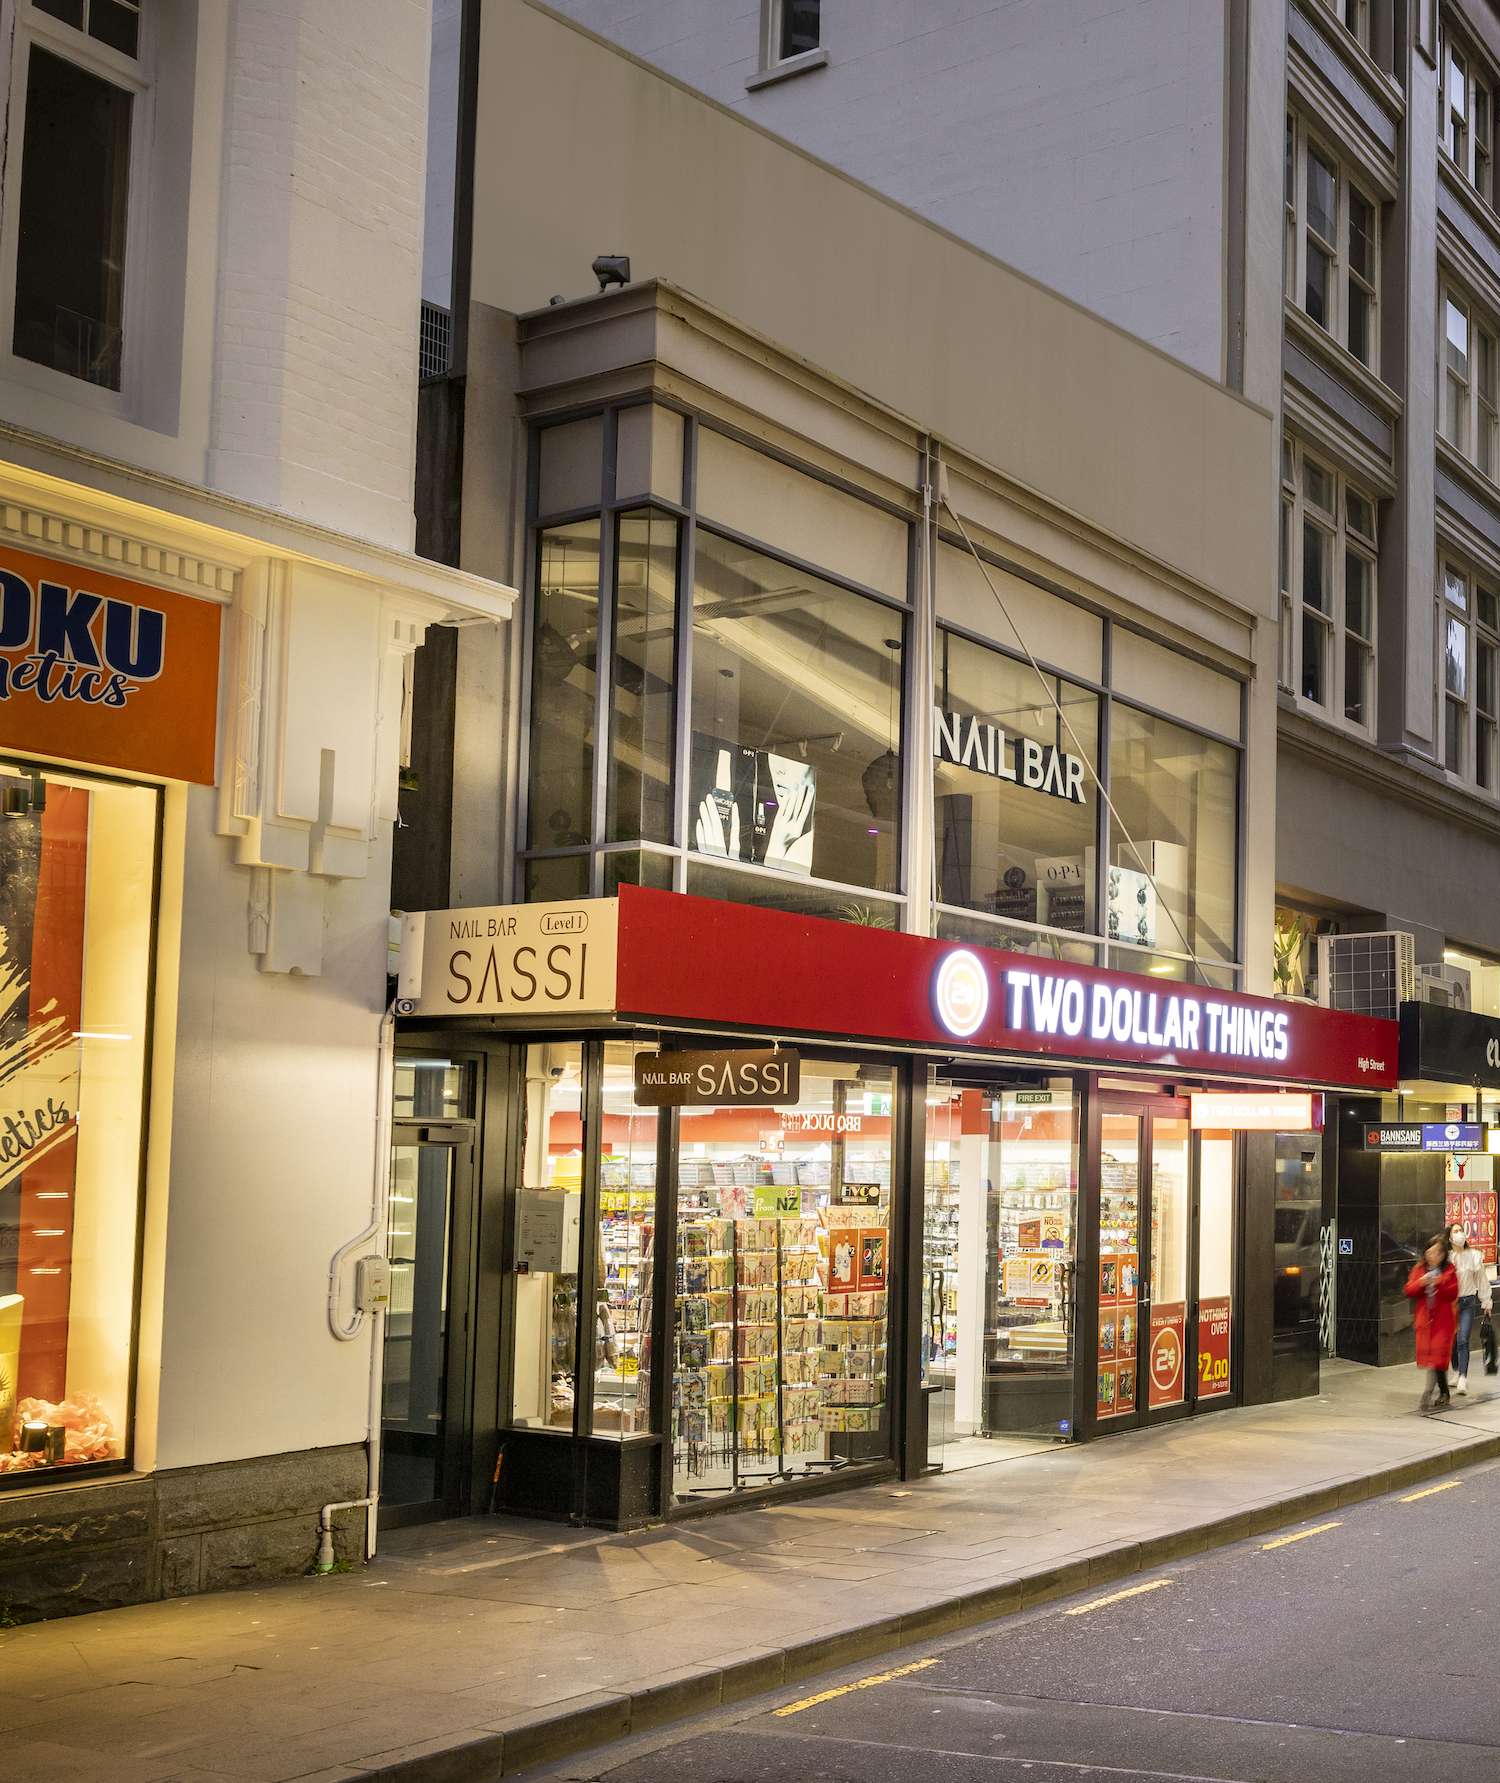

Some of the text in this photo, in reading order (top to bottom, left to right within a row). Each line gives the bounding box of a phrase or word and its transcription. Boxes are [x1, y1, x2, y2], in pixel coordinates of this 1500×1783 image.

[934, 706, 1087, 804] NAIL BAR
[450, 917, 517, 939] NAIL BAR
[547, 916, 575, 931] Level
[447, 943, 587, 1004] SASSI
[1006, 970, 1289, 1061] TWO DOLLAR THINGS
[1358, 1057, 1385, 1072] High Street
[642, 1060, 789, 1096] NAIL BAR SASSI
[1017, 1094, 1051, 1103] FIRE EXIT
[1380, 1129, 1421, 1142] BANNSANG
[756, 1197, 798, 1211] from NZ
[1199, 1307, 1229, 1323] NOTHING
[1210, 1321, 1228, 1336] OVER
[1198, 1352, 1229, 1382] $2.00
